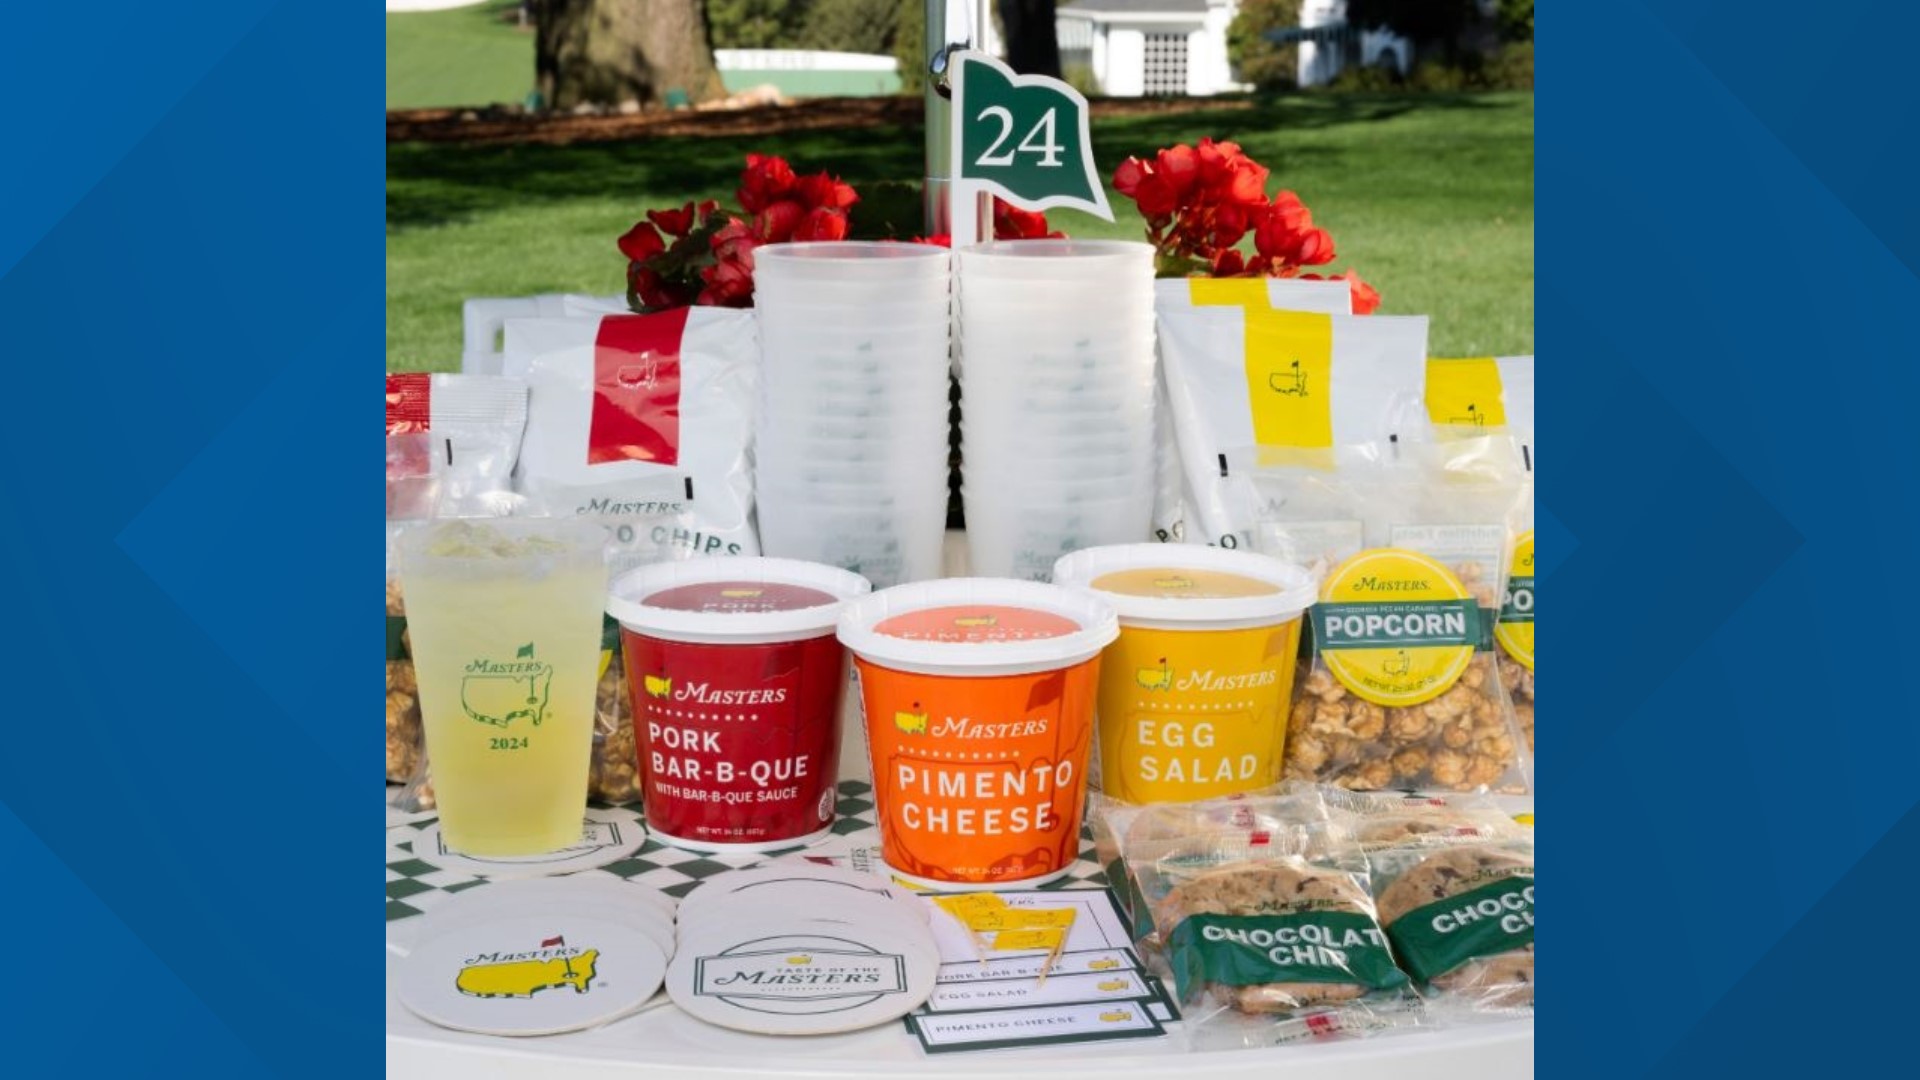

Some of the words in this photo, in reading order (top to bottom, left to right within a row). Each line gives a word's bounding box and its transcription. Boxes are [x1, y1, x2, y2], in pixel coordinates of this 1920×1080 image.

[975, 106, 1065, 167] 24
[651, 526, 742, 556] CHIPS
[1325, 612, 1466, 638] POPCORN
[465, 659, 542, 672] MASTERS
[1176, 670, 1276, 691] MASTERS
[675, 682, 787, 704] MASTERS
[649, 722, 721, 753] PORK
[932, 716, 1048, 738] MASTERS
[1137, 720, 1215, 747] EGG
[490, 737, 528, 749] 2024
[652, 752, 809, 786] BAR-B-QUE
[898, 760, 1072, 798] PIMENTO
[1140, 755, 1257, 782] SALAD
[656, 781, 680, 798] WITH
[683, 787, 752, 804] BAR-B-QUE
[757, 786, 798, 802] SAUCE
[902, 802, 1052, 836] CHEESE
[464, 947, 580, 965] MASTERS
[1269, 945, 1349, 966] CHIP
[714, 971, 880, 985] MASTERS
[976, 989, 1027, 998] SALAD
[936, 1022, 1010, 1032] PIMENTO
[1013, 1016, 1078, 1026] CHEESE
